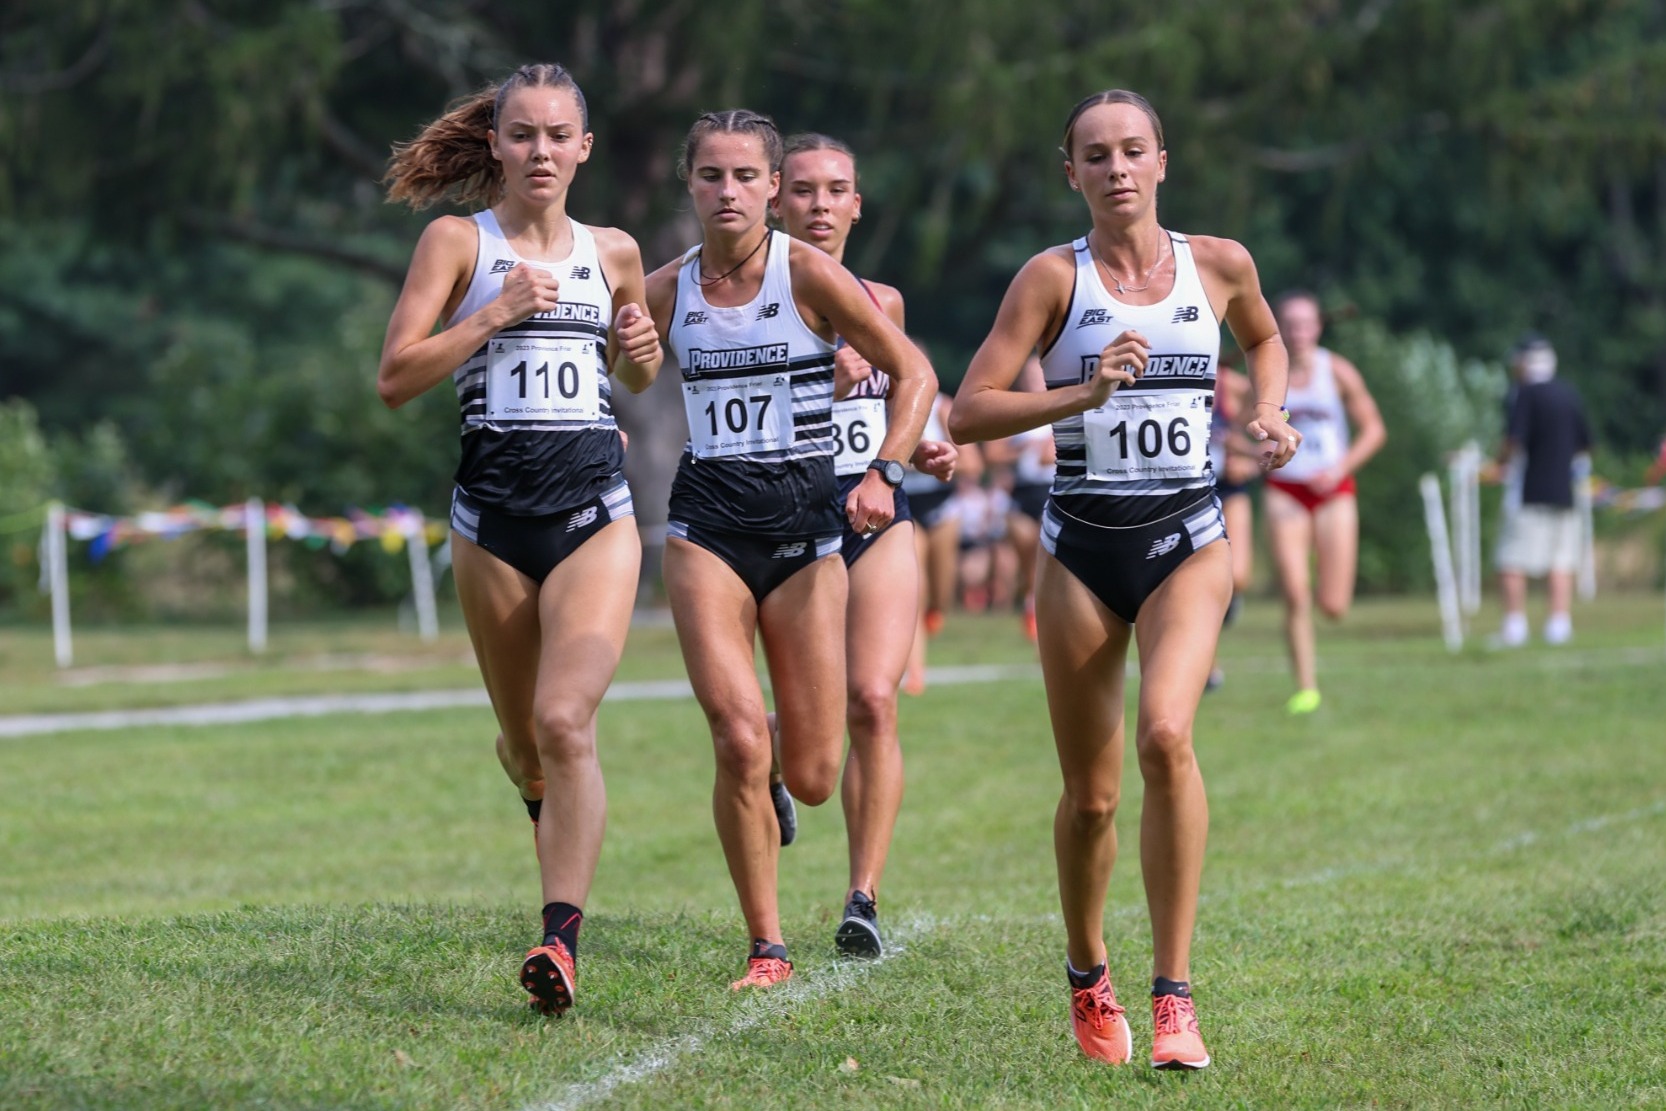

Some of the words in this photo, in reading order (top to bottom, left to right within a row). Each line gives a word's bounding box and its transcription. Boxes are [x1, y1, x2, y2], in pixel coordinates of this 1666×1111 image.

[1078, 316, 1114, 325] EAST
[1083, 308, 1108, 317] BIG
[510, 360, 579, 399] 110
[1083, 355, 1209, 385] PDENCE
[704, 394, 772, 436] 107
[720, 441, 745, 449] Country
[1109, 416, 1191, 459] 106
[1106, 467, 1128, 475] Cross
[1128, 466, 1157, 474] Country
